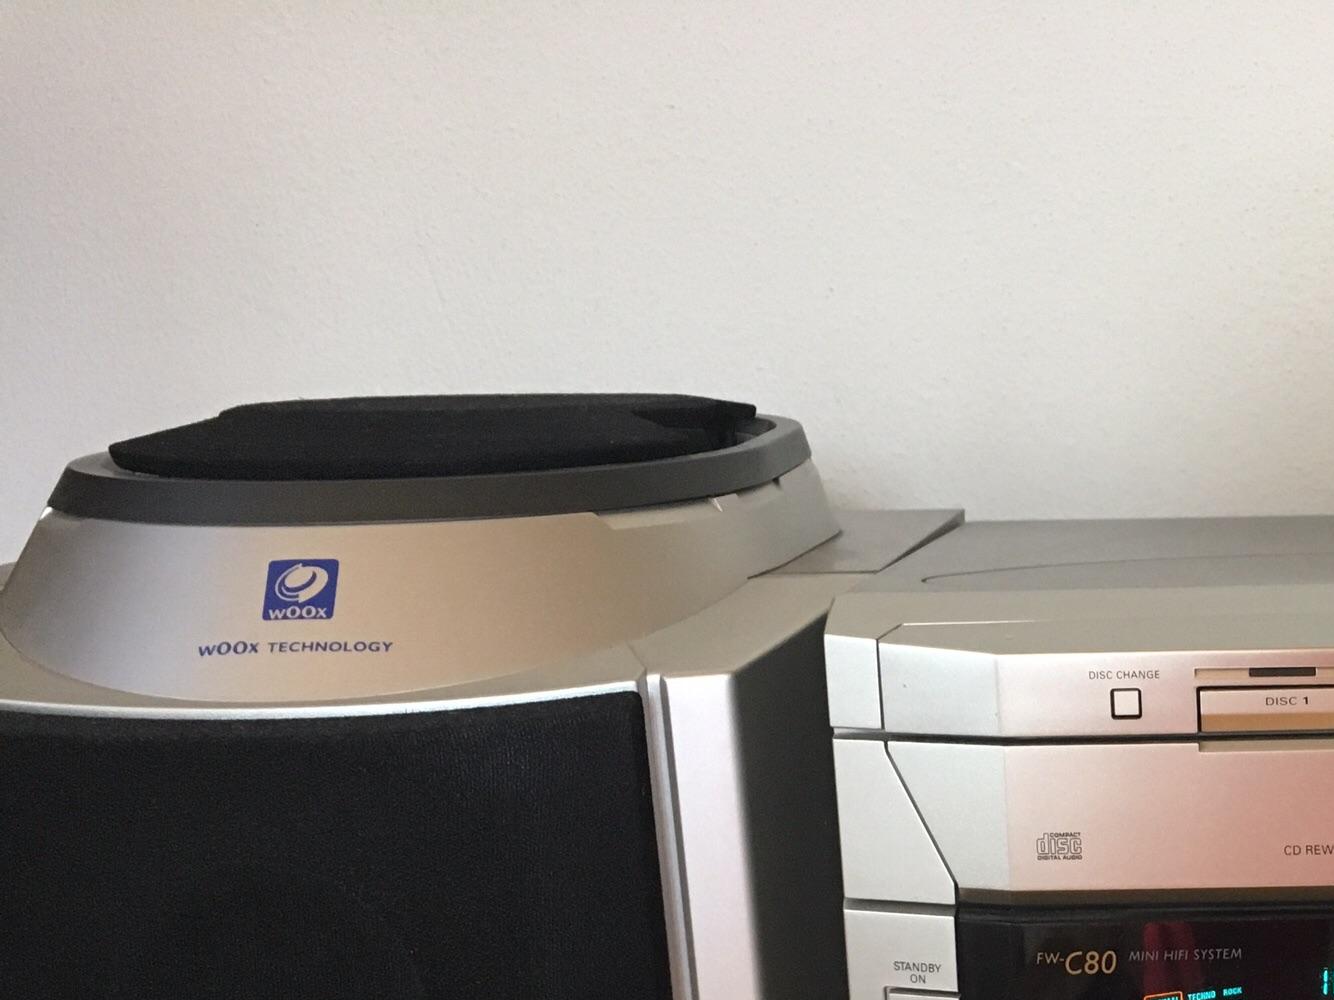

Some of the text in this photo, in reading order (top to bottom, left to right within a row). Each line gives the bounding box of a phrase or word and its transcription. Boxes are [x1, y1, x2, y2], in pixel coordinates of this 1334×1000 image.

[268, 641, 393, 653] TECHNOLOGY
[1088, 670, 1160, 680] DISC CHANGE
[1265, 696, 1310, 706] DISC 1
[1284, 845, 1302, 856] CD
[1129, 948, 1242, 961] MINI HIFI SYSTEM
[893, 961, 942, 973] STANDBY
[1036, 950, 1117, 975] FW-C80
[910, 974, 926, 984] ON
[1223, 986, 1242, 996] ROCK
